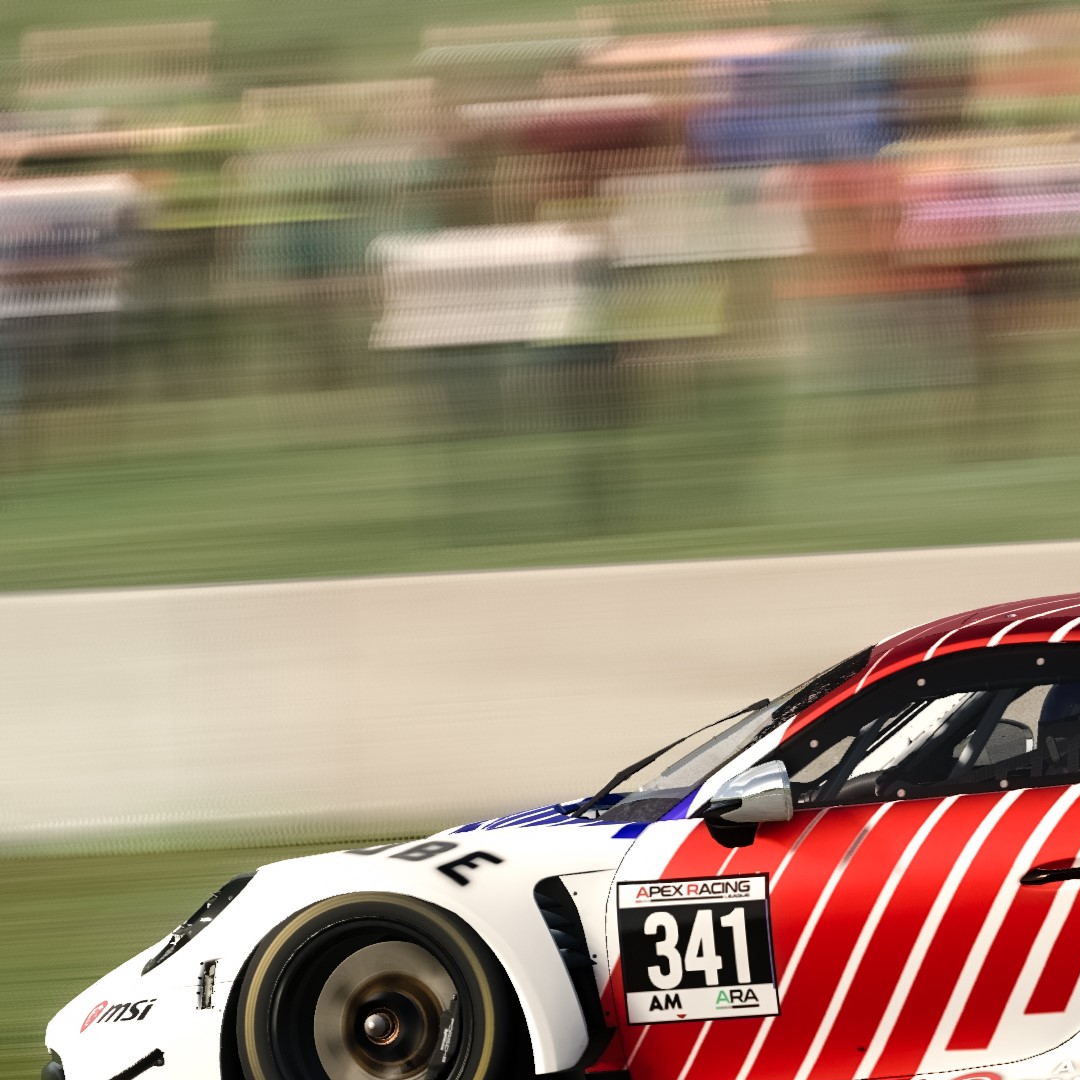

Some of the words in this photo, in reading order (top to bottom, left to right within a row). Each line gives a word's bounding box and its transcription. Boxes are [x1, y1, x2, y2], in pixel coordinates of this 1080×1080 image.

[636, 884, 683, 899] APEX
[687, 880, 751, 896] RACING
[643, 907, 752, 990] 341
[649, 993, 683, 1012] AM
[715, 988, 759, 1005] ARA
[96, 998, 158, 1024] msi
